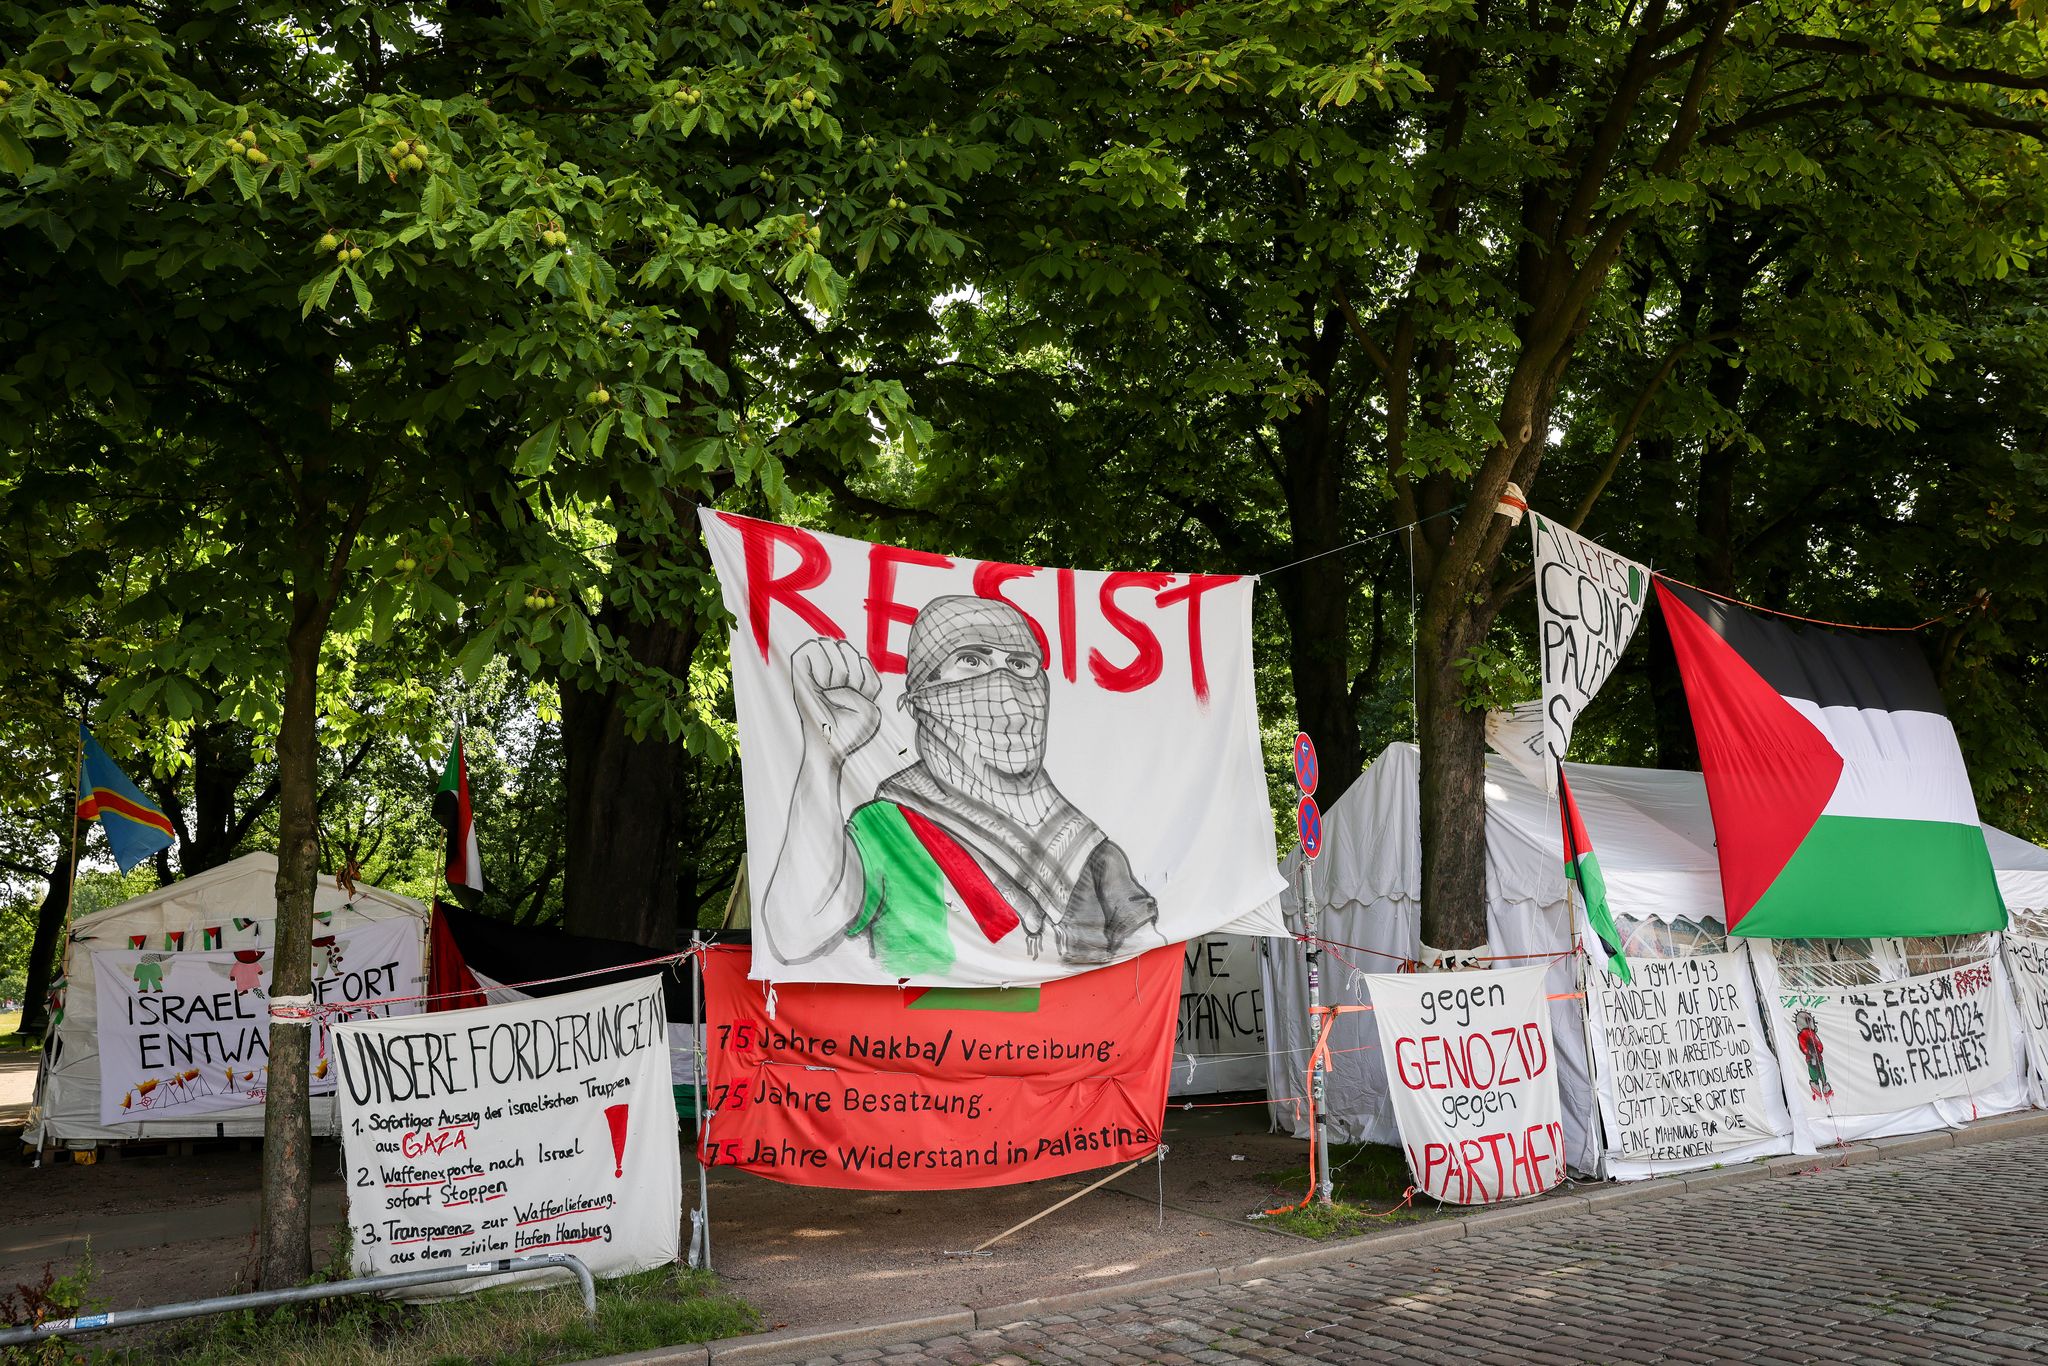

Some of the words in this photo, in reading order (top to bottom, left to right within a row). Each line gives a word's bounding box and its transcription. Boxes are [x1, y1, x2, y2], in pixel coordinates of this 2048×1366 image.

[1535, 514, 1588, 575] ALL
[1579, 540, 1629, 599] EYES
[716, 511, 1243, 712] RESIST
[127, 989, 256, 1026] ISRAEL
[268, 961, 399, 1005] FORT
[1644, 959, 1719, 988] 1941-1943
[1420, 983, 1505, 1027] gegen
[1602, 989, 1667, 1024] FANDEN
[1678, 988, 1700, 1016] AUF
[1707, 983, 1740, 1012] DER
[1855, 1008, 1899, 1044] Seit:
[1899, 1000, 1985, 1047] 06.05.2024
[336, 1032, 467, 1107] UNSERE
[468, 987, 665, 1089] FORDERUNGEN
[716, 1024, 753, 1050] 75
[757, 1027, 838, 1057] Jahre
[961, 1037, 1122, 1063] Vertreibung.
[1395, 1022, 1548, 1091] GENOZID
[1611, 1048, 1662, 1072] TIONEN
[1667, 1050, 1679, 1066] IN
[1617, 1058, 1754, 1099] KONZENTRATIONSLAGER
[1872, 1052, 1908, 1088] Bis:
[351, 1118, 364, 1136] 1.
[368, 1113, 434, 1135] Sofortiger
[438, 1109, 480, 1130] Auszug
[484, 1106, 503, 1120] der
[507, 1092, 579, 1116] israelischen
[579, 1077, 631, 1099] Truppen
[714, 1083, 748, 1112] 75
[753, 1079, 832, 1113] Jahre
[843, 1087, 993, 1120] Besatzung.
[1442, 1090, 1517, 1128] gegen
[1618, 1095, 1656, 1126] STATT
[1660, 1092, 1705, 1117] DIESER
[1705, 1088, 1727, 1111] ORT
[1729, 1088, 1746, 1106] IST
[375, 1141, 400, 1153] aus
[401, 1129, 468, 1159] GAZA
[706, 1142, 739, 1169] 75
[747, 1138, 828, 1169] Jahre
[838, 1141, 998, 1171] Widerstand
[1007, 1141, 1028, 1165] in
[1033, 1122, 1149, 1161] Palästina
[1620, 1127, 1650, 1154] EINE
[1655, 1123, 1700, 1145] MAHNUNG
[1724, 1114, 1747, 1131] DIE
[1650, 1140, 1714, 1161] LEBENDEN
[356, 1167, 375, 1188] 2.
[379, 1157, 485, 1185] Waffenexporte
[489, 1149, 524, 1172] nach
[538, 1137, 584, 1163] Israel
[385, 1187, 432, 1210] sofort
[440, 1180, 508, 1205] Stoppen
[361, 1223, 382, 1246] 3.
[382, 1219, 475, 1243] Transparenz
[481, 1217, 509, 1230] zur
[389, 1252, 415, 1265] aus
[420, 1245, 452, 1260] dem
[460, 1234, 509, 1257] zivilen
[514, 1228, 551, 1249] Hafen
[555, 1221, 613, 1243] Hamburg
